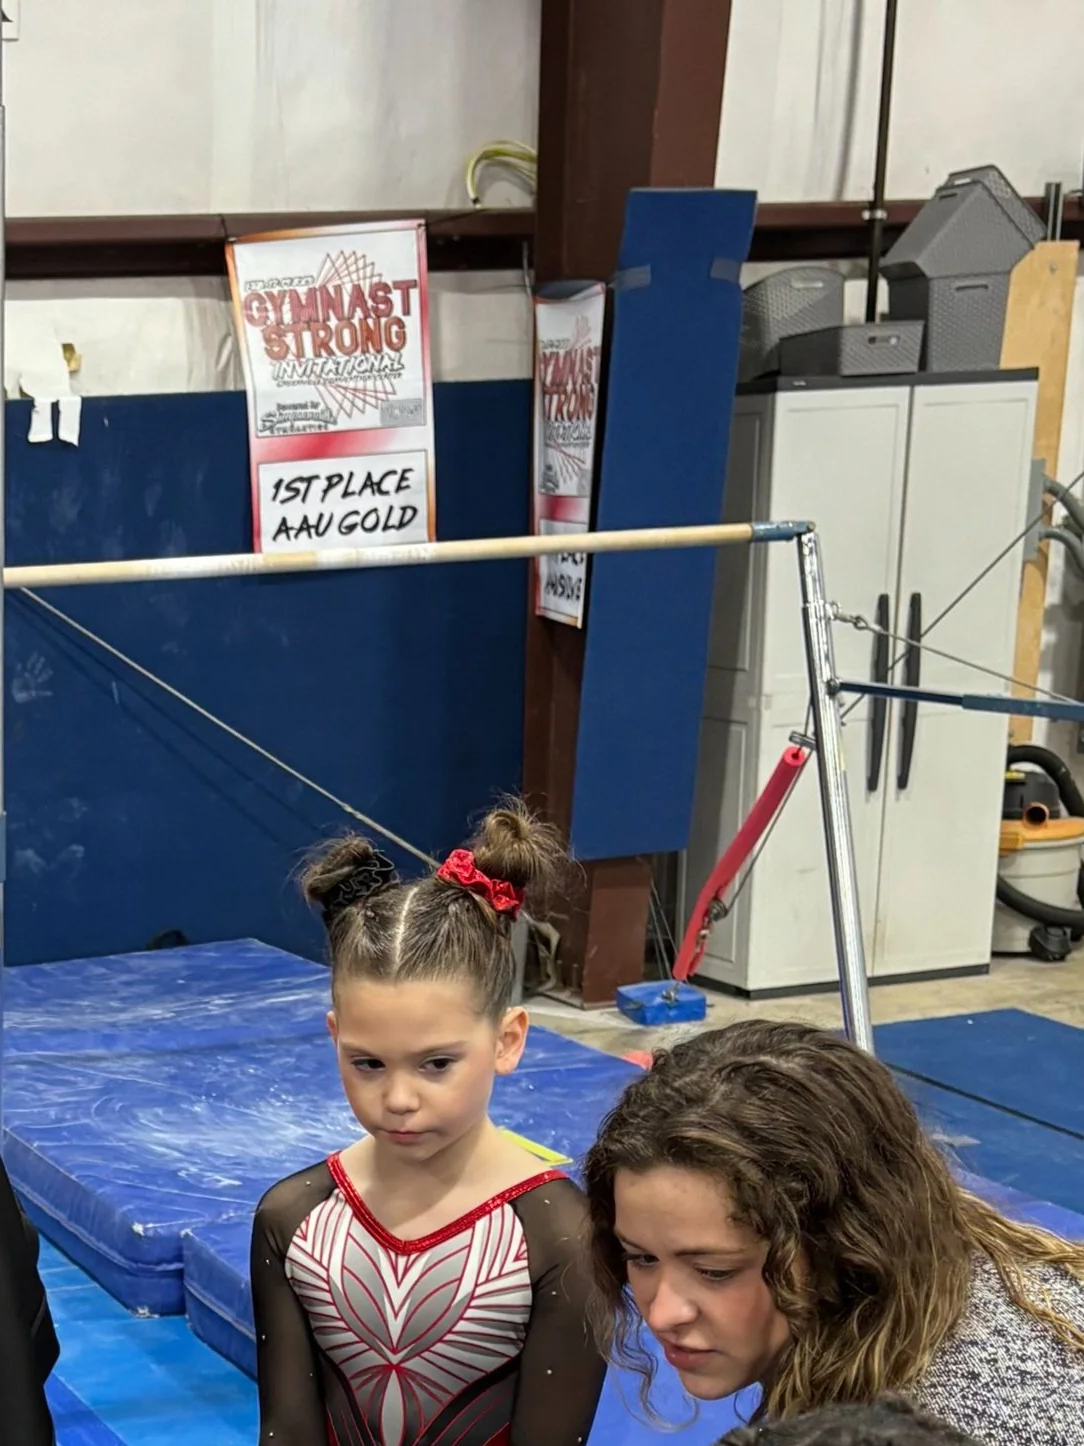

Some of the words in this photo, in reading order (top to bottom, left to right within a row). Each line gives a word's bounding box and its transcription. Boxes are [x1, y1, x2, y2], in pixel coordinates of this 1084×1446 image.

[244, 279, 418, 327] GYMNAST
[262, 315, 407, 361] STRONG
[271, 353, 405, 381] INVITATIONAL
[272, 475, 320, 505] 1ST
[321, 468, 415, 503] PLACE
[272, 512, 334, 542] AAU
[338, 505, 419, 536] GOLD
